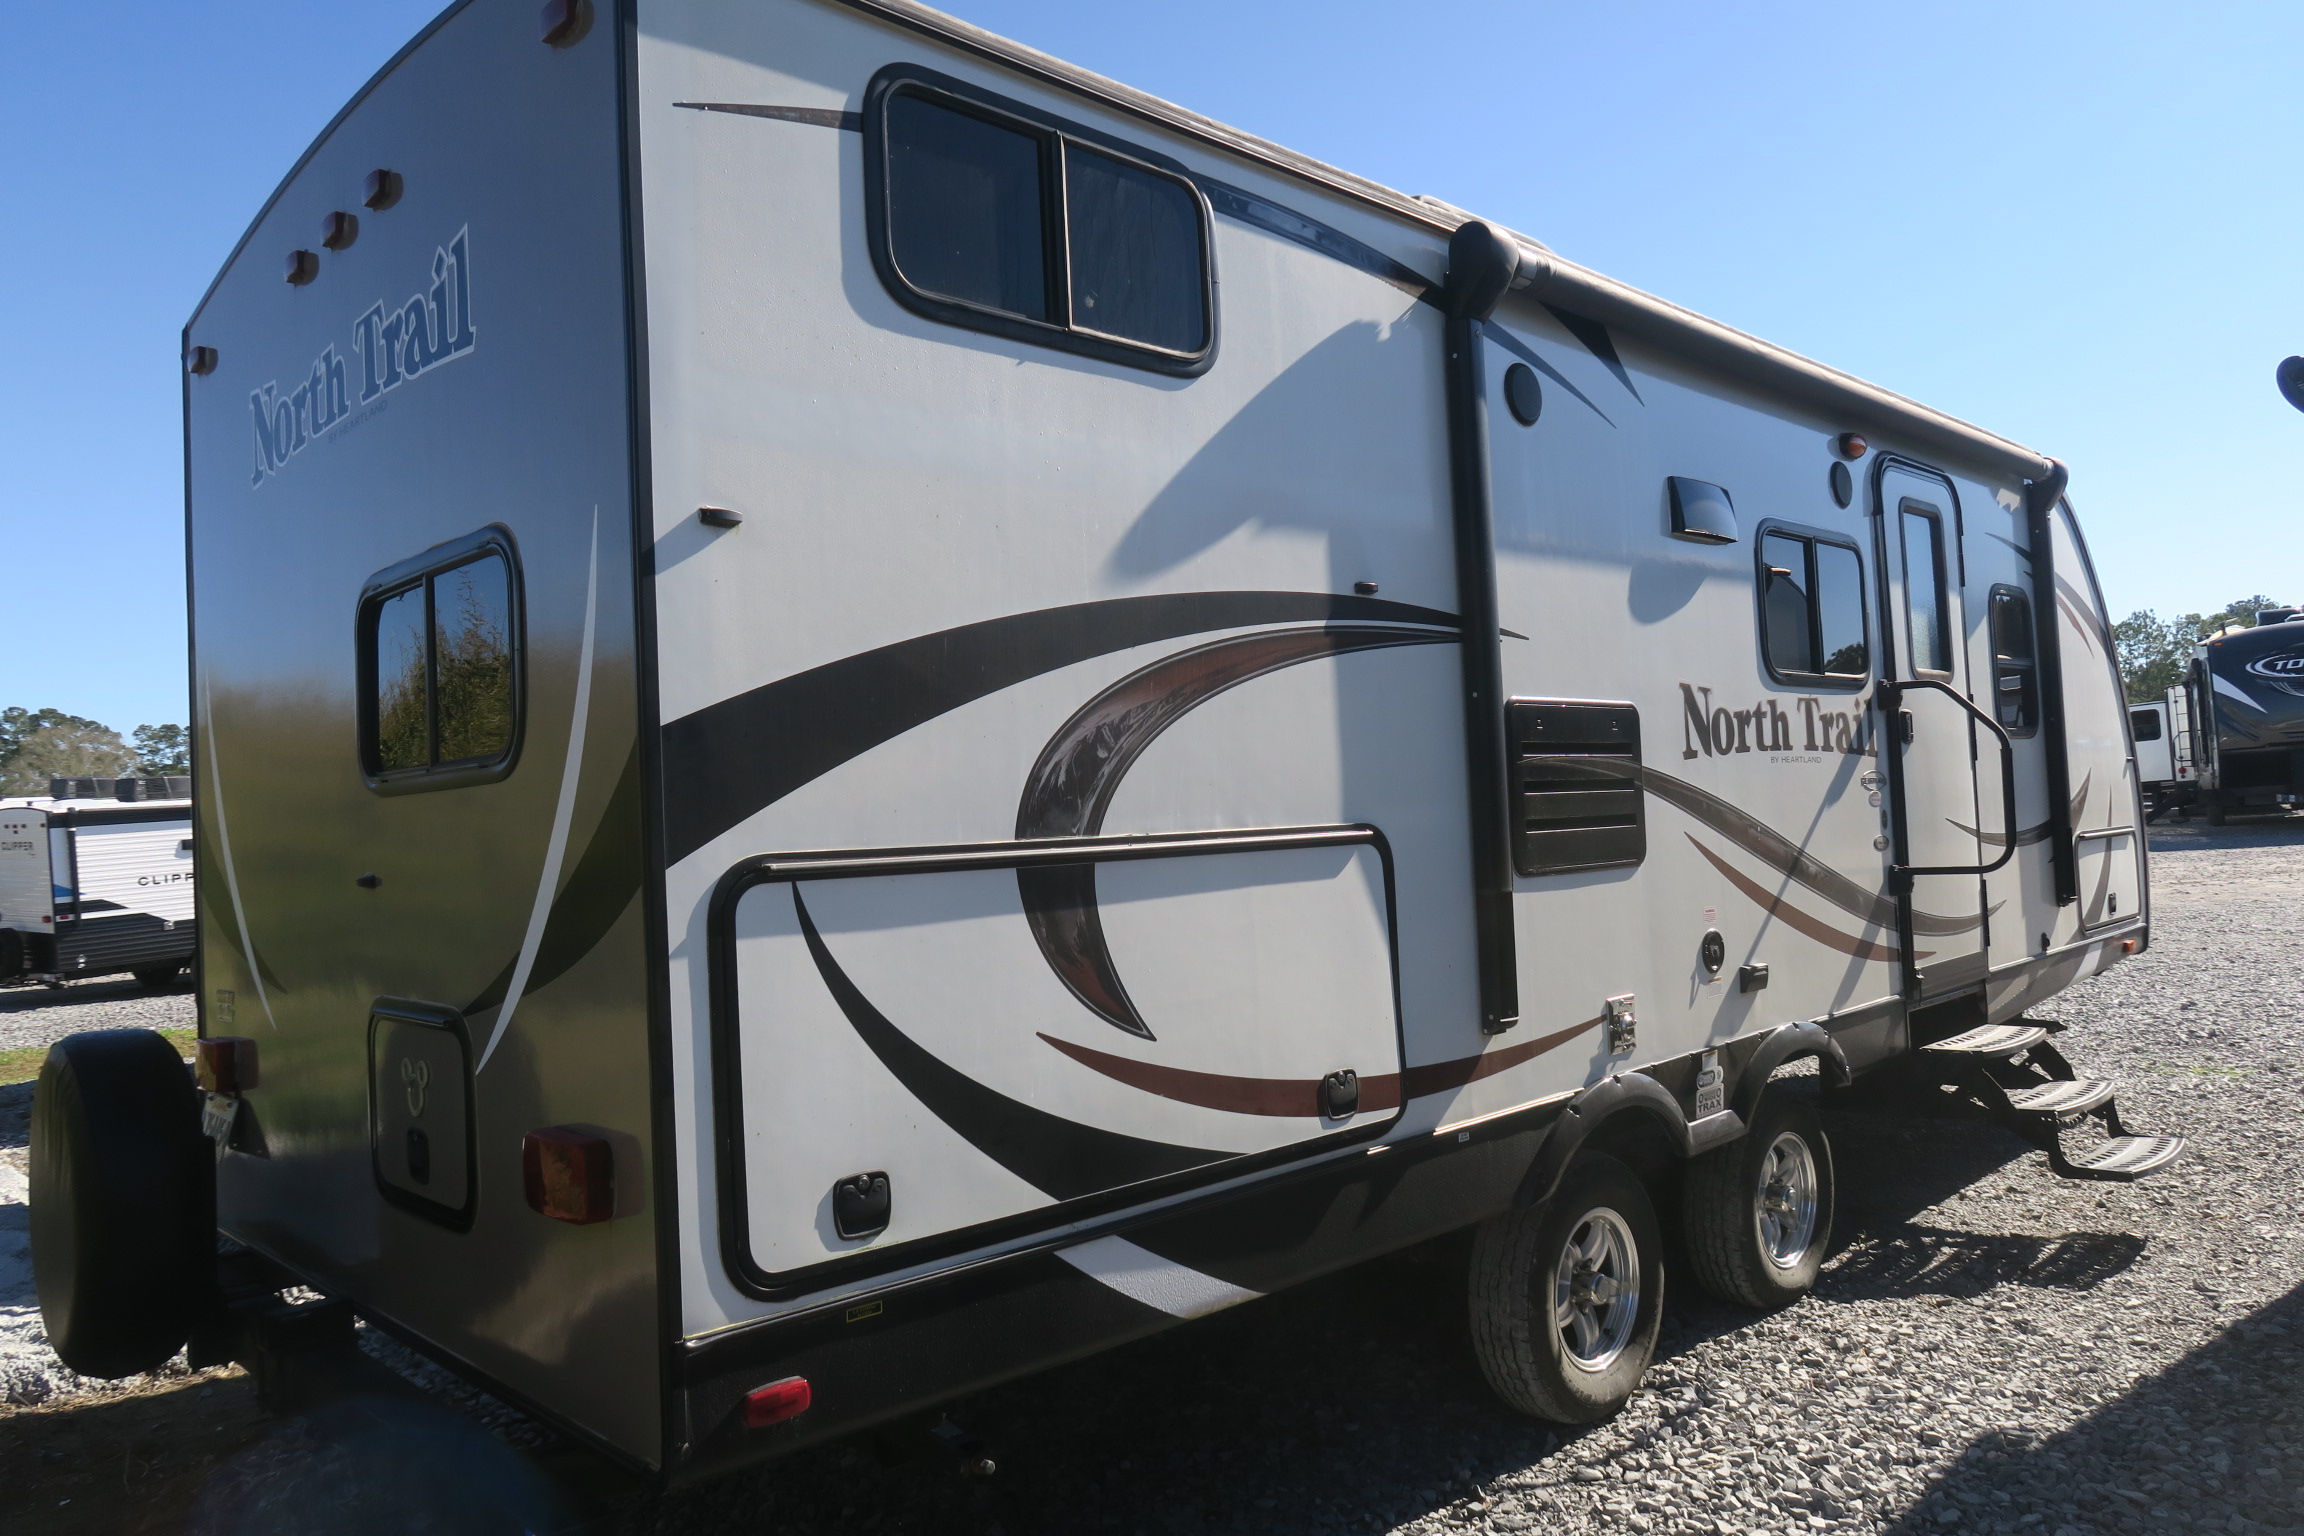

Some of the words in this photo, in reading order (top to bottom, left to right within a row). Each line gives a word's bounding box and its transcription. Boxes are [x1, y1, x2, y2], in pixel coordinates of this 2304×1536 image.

[250, 343, 350, 490] North
[353, 223, 476, 406] Trail
[1679, 683, 1793, 760] North
[1797, 697, 1878, 758] Trail
[1781, 756, 1821, 764] HEARTLAND
[1698, 1098, 1722, 1113] TRAX
